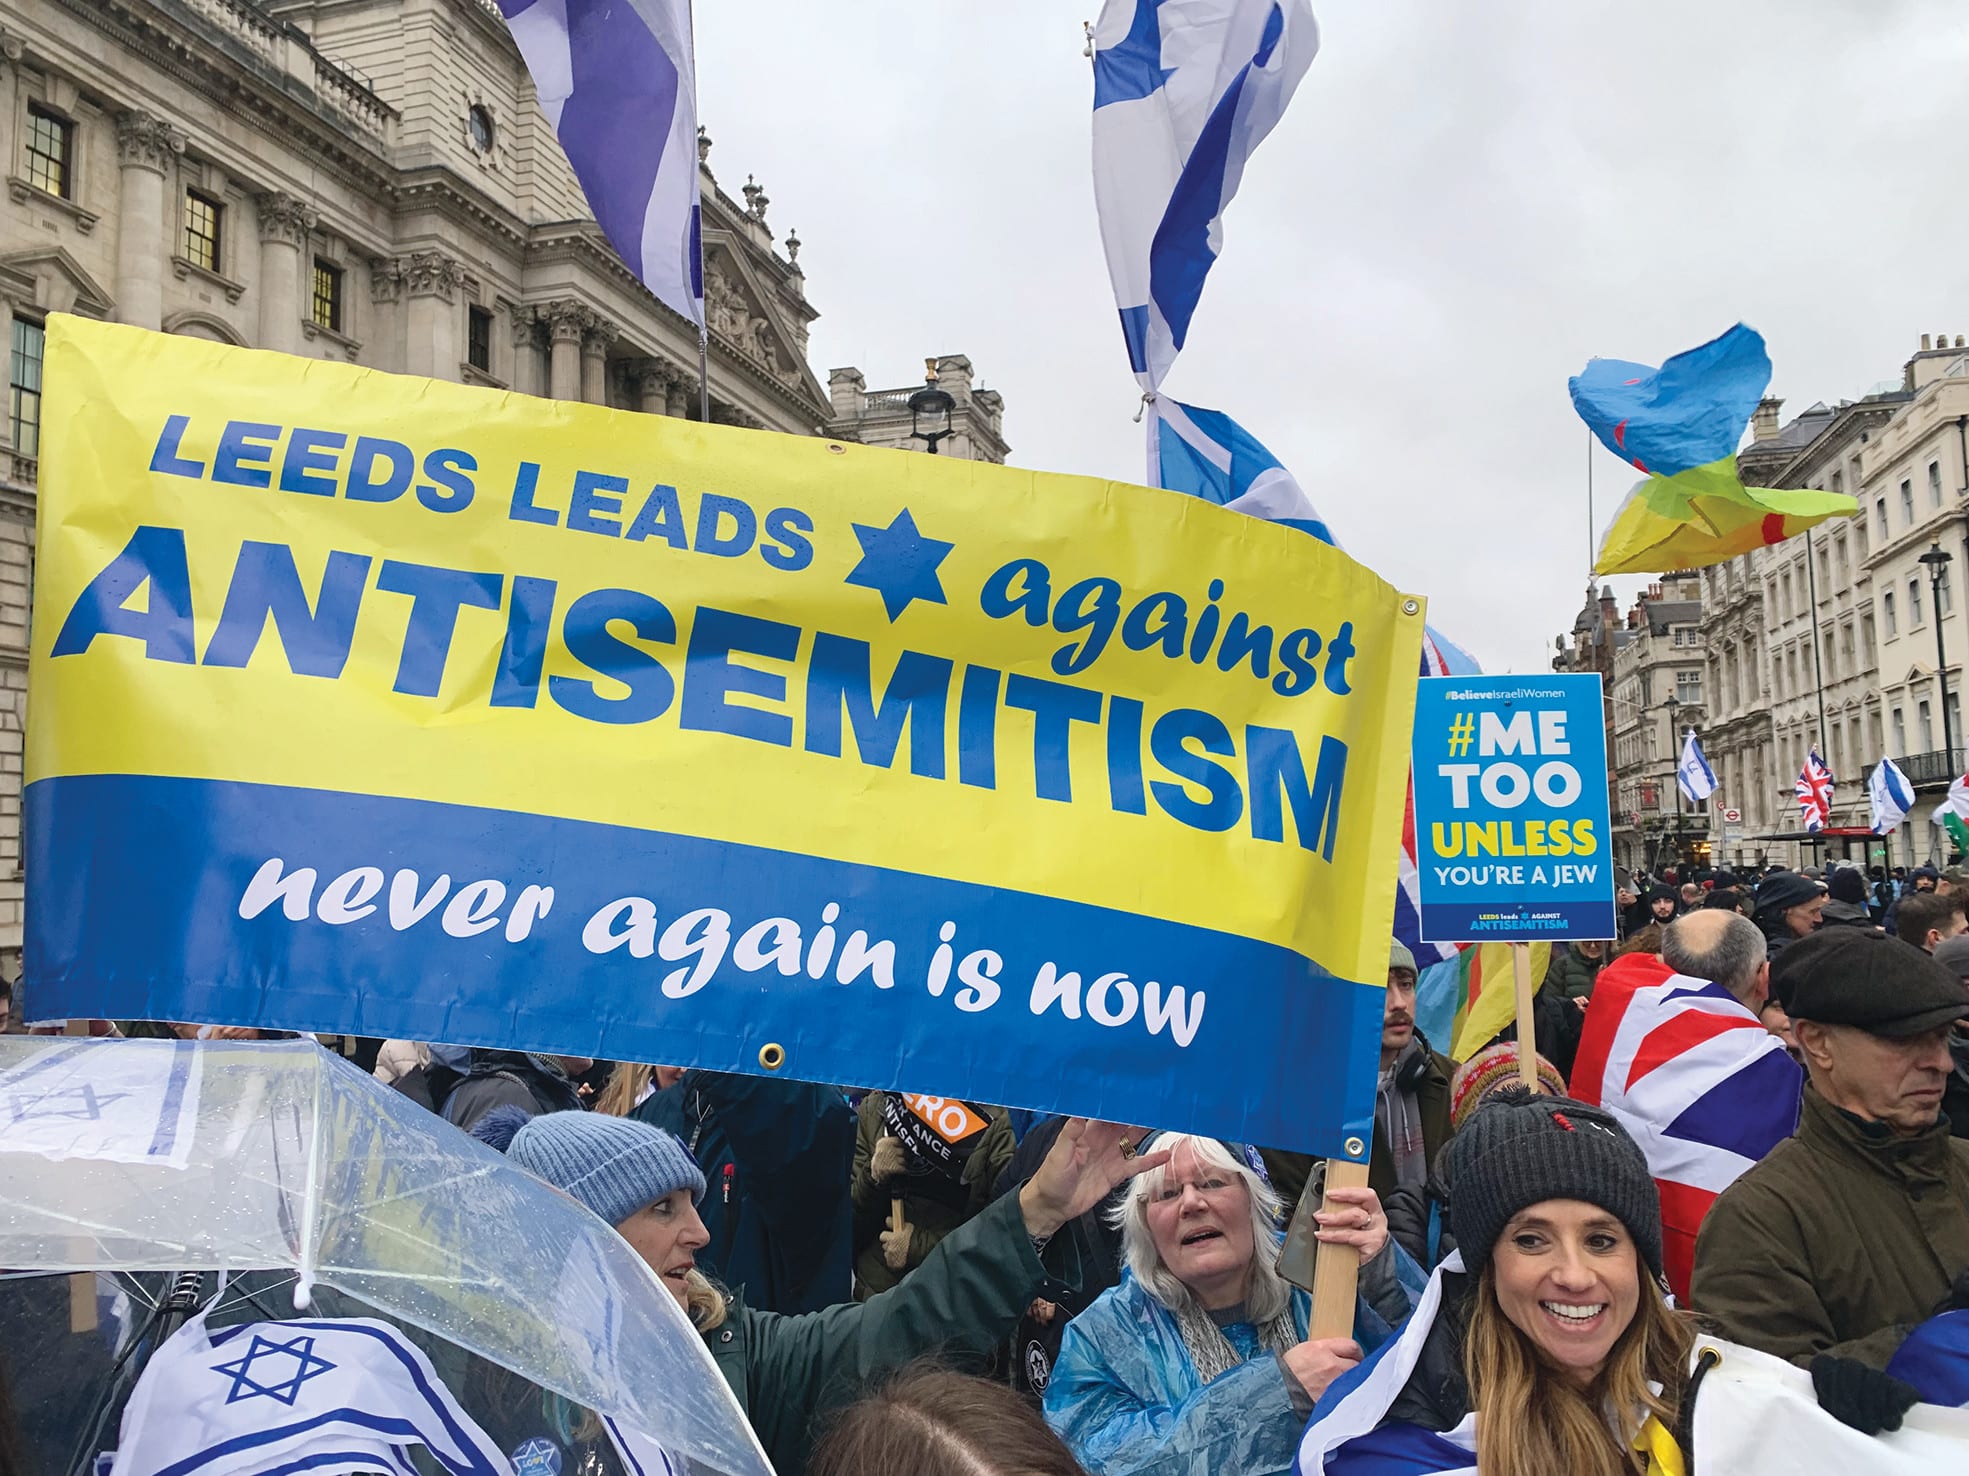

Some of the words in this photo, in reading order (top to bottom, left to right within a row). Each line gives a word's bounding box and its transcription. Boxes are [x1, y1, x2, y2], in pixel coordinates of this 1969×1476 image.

[149, 415, 479, 513] LEEDS
[508, 462, 814, 572] LEADS
[980, 558, 1356, 697] against
[50, 525, 1349, 864] ANTISEMITISM
[1445, 688, 1566, 701] #BelieveIsraeliWomen
[1447, 710, 1571, 757] #ME
[1438, 761, 1582, 809] TOO
[1431, 819, 1598, 858] UNLESS
[1434, 866, 1525, 886] YOU'RE
[1531, 866, 1548, 885] A
[1552, 865, 1598, 888] JEW
[1470, 919, 1569, 931] ANTISEMITISM
[1531, 912, 1561, 920] AGAINST
[238, 857, 555, 942] never
[581, 902, 896, 999] again
[927, 921, 1003, 1012] is
[1029, 962, 1207, 1047] now
